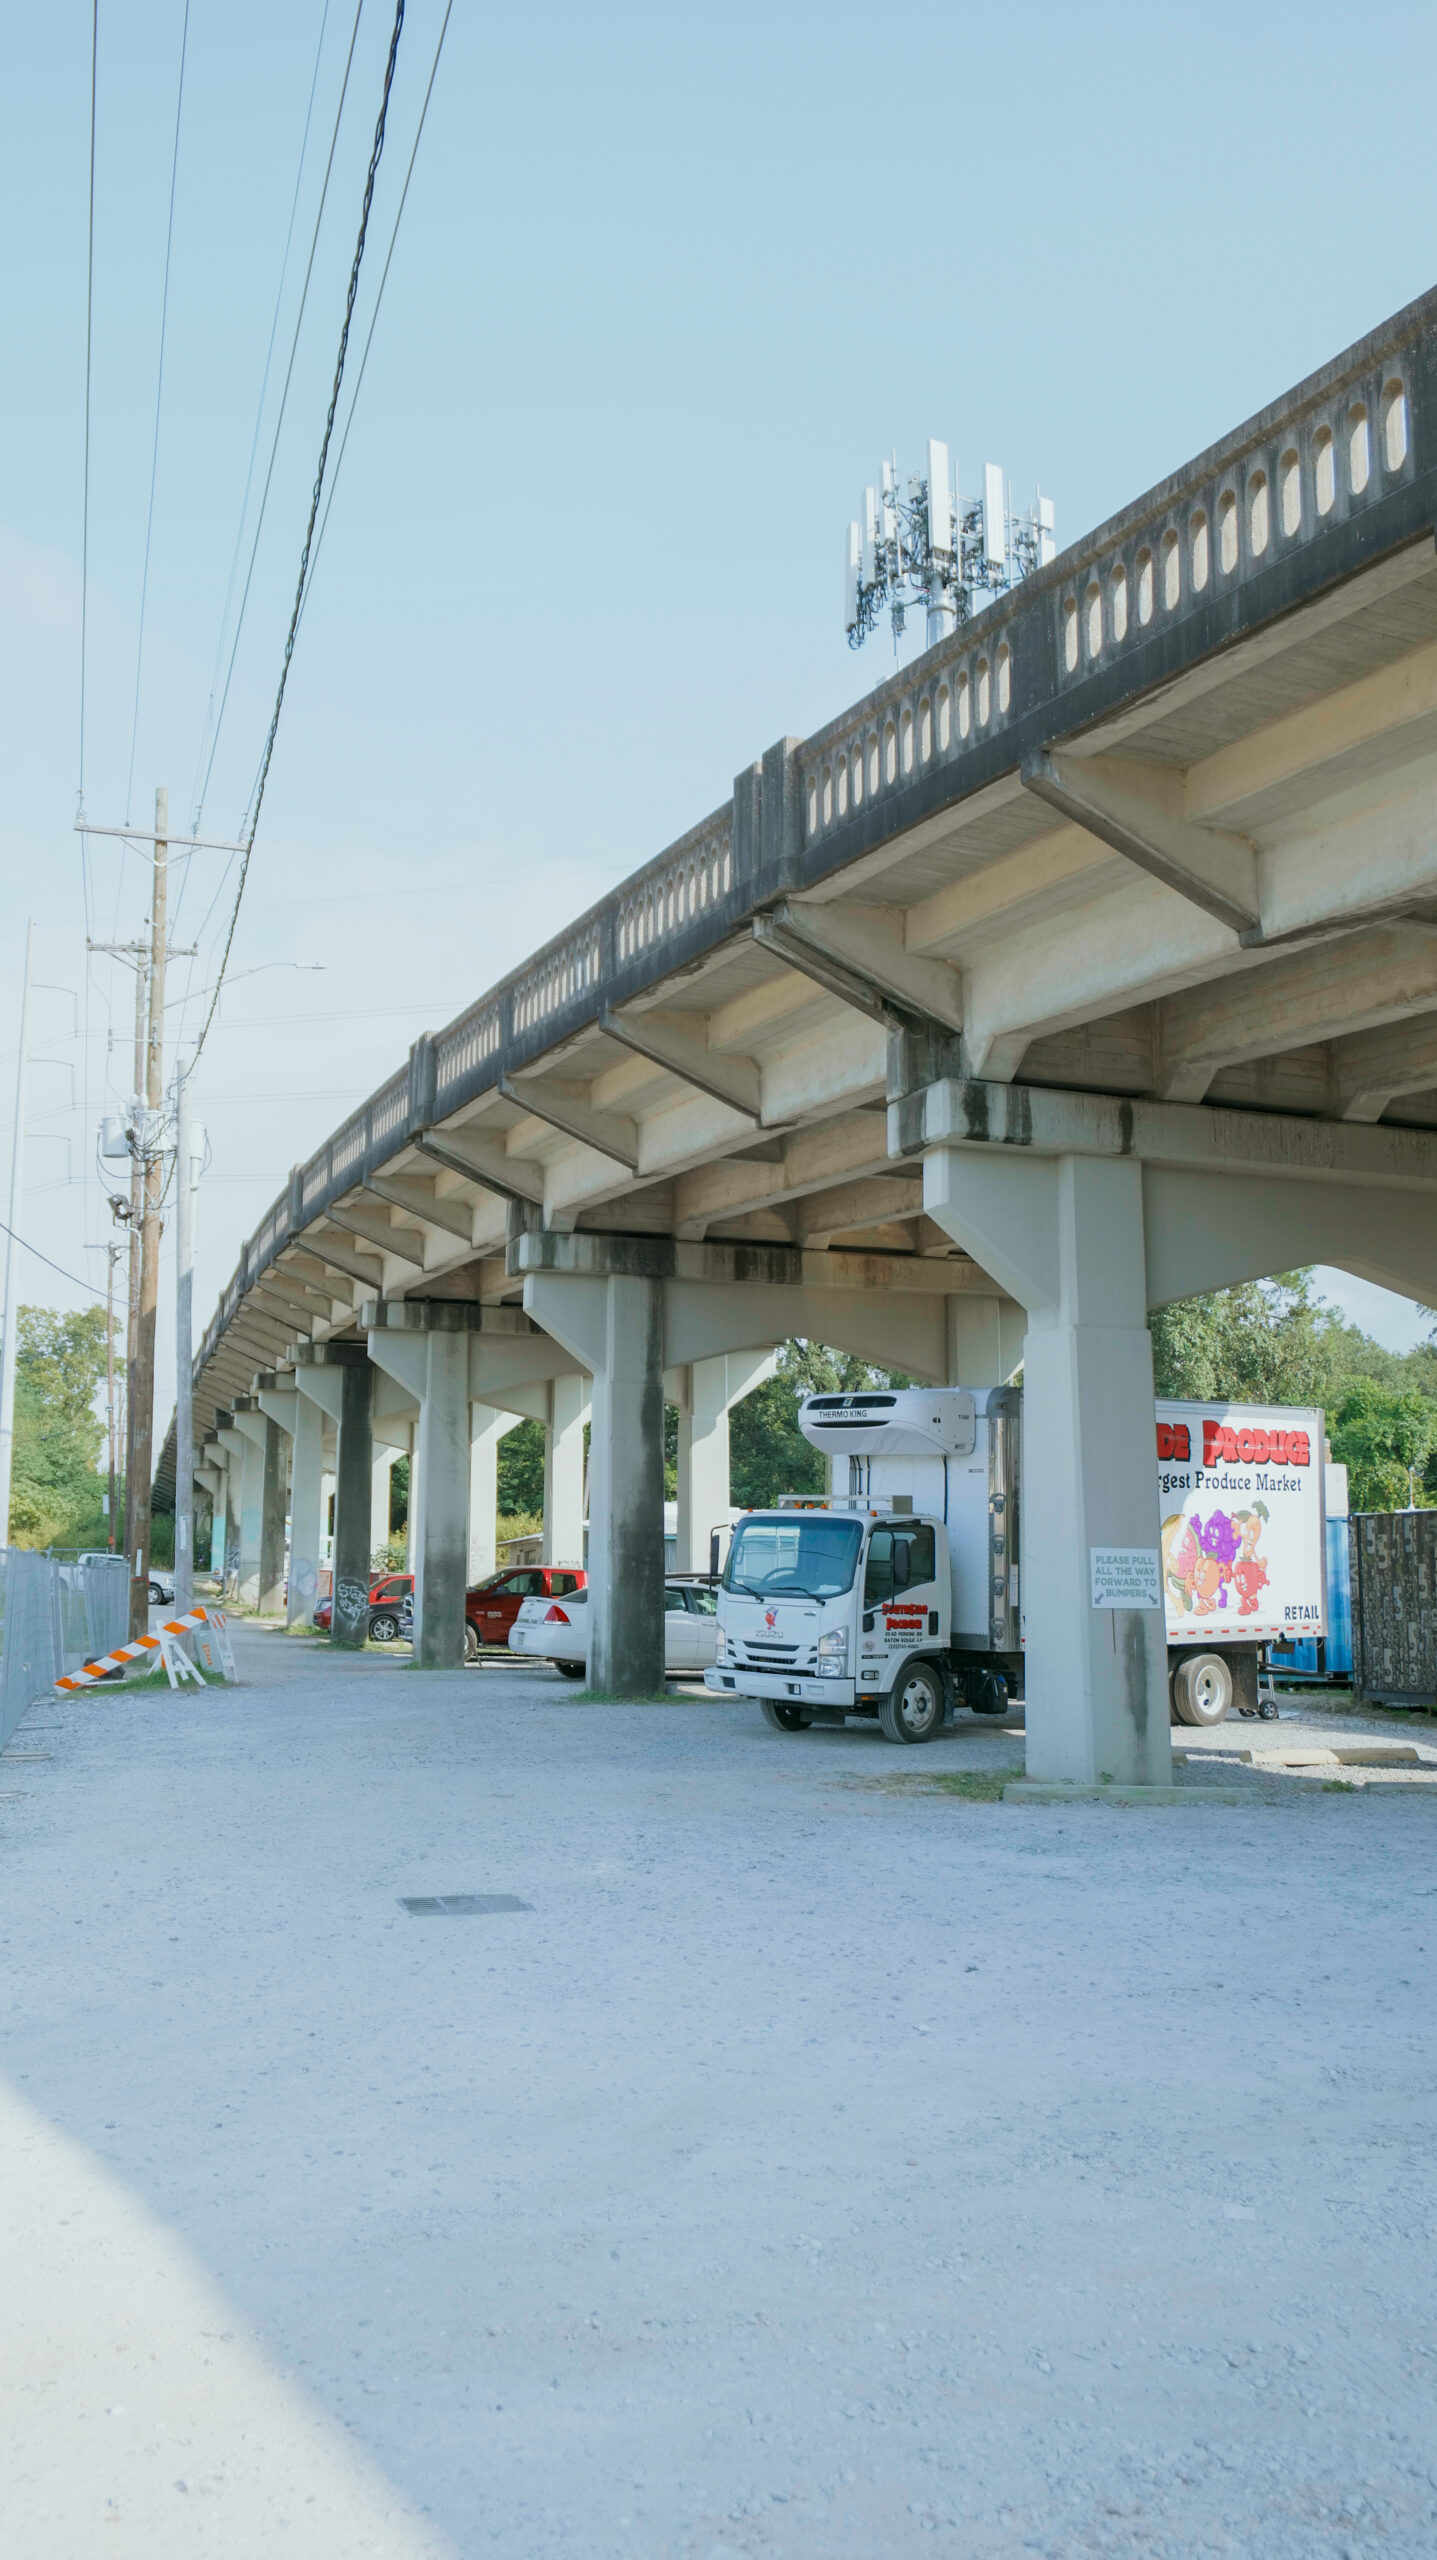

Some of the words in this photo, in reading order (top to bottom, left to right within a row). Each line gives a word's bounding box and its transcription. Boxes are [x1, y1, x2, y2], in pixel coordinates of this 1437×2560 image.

[819, 1410, 848, 1419] THERMO
[850, 1410, 868, 1418] KING
[1202, 1420, 1310, 1468] PRODUCE
[1195, 1471, 1251, 1490] Produce
[1256, 1473, 1302, 1491] Market
[1096, 1555, 1130, 1565] PLEASE
[1132, 1556, 1154, 1565] PULL
[1095, 1567, 1112, 1575] ALL
[1115, 1567, 1132, 1575] THE
[1135, 1567, 1155, 1576] WAY
[1095, 1578, 1141, 1586] FORWARD
[1144, 1578, 1157, 1587] TO
[1106, 1589, 1147, 1598] BUMPERS
[1285, 1605, 1319, 1620] RETAIL
